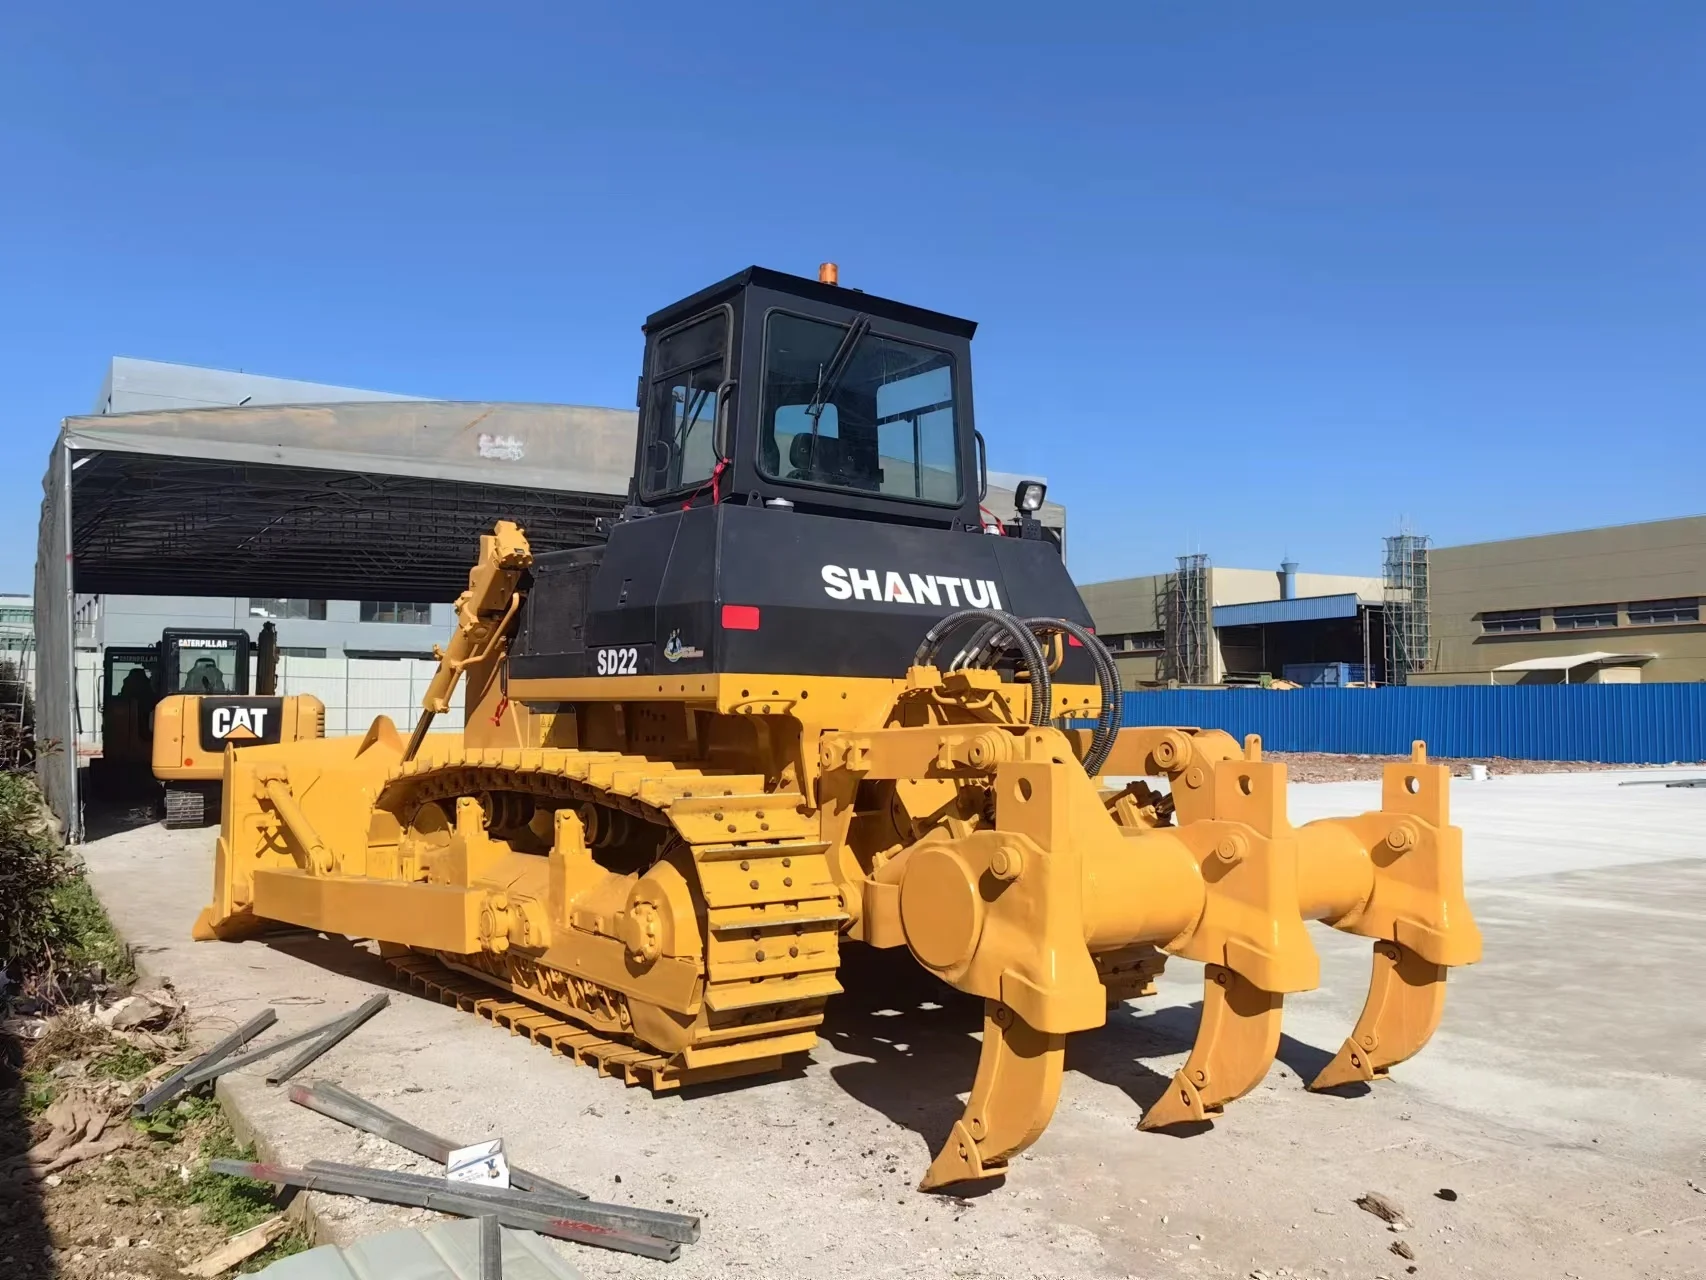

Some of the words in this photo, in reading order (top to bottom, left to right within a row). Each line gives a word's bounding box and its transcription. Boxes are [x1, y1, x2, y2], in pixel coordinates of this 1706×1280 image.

[821, 564, 1002, 610] SHANTUI
[178, 639, 228, 648] CATERPILLAR
[597, 648, 638, 675] SD22
[212, 708, 268, 738] CAT
